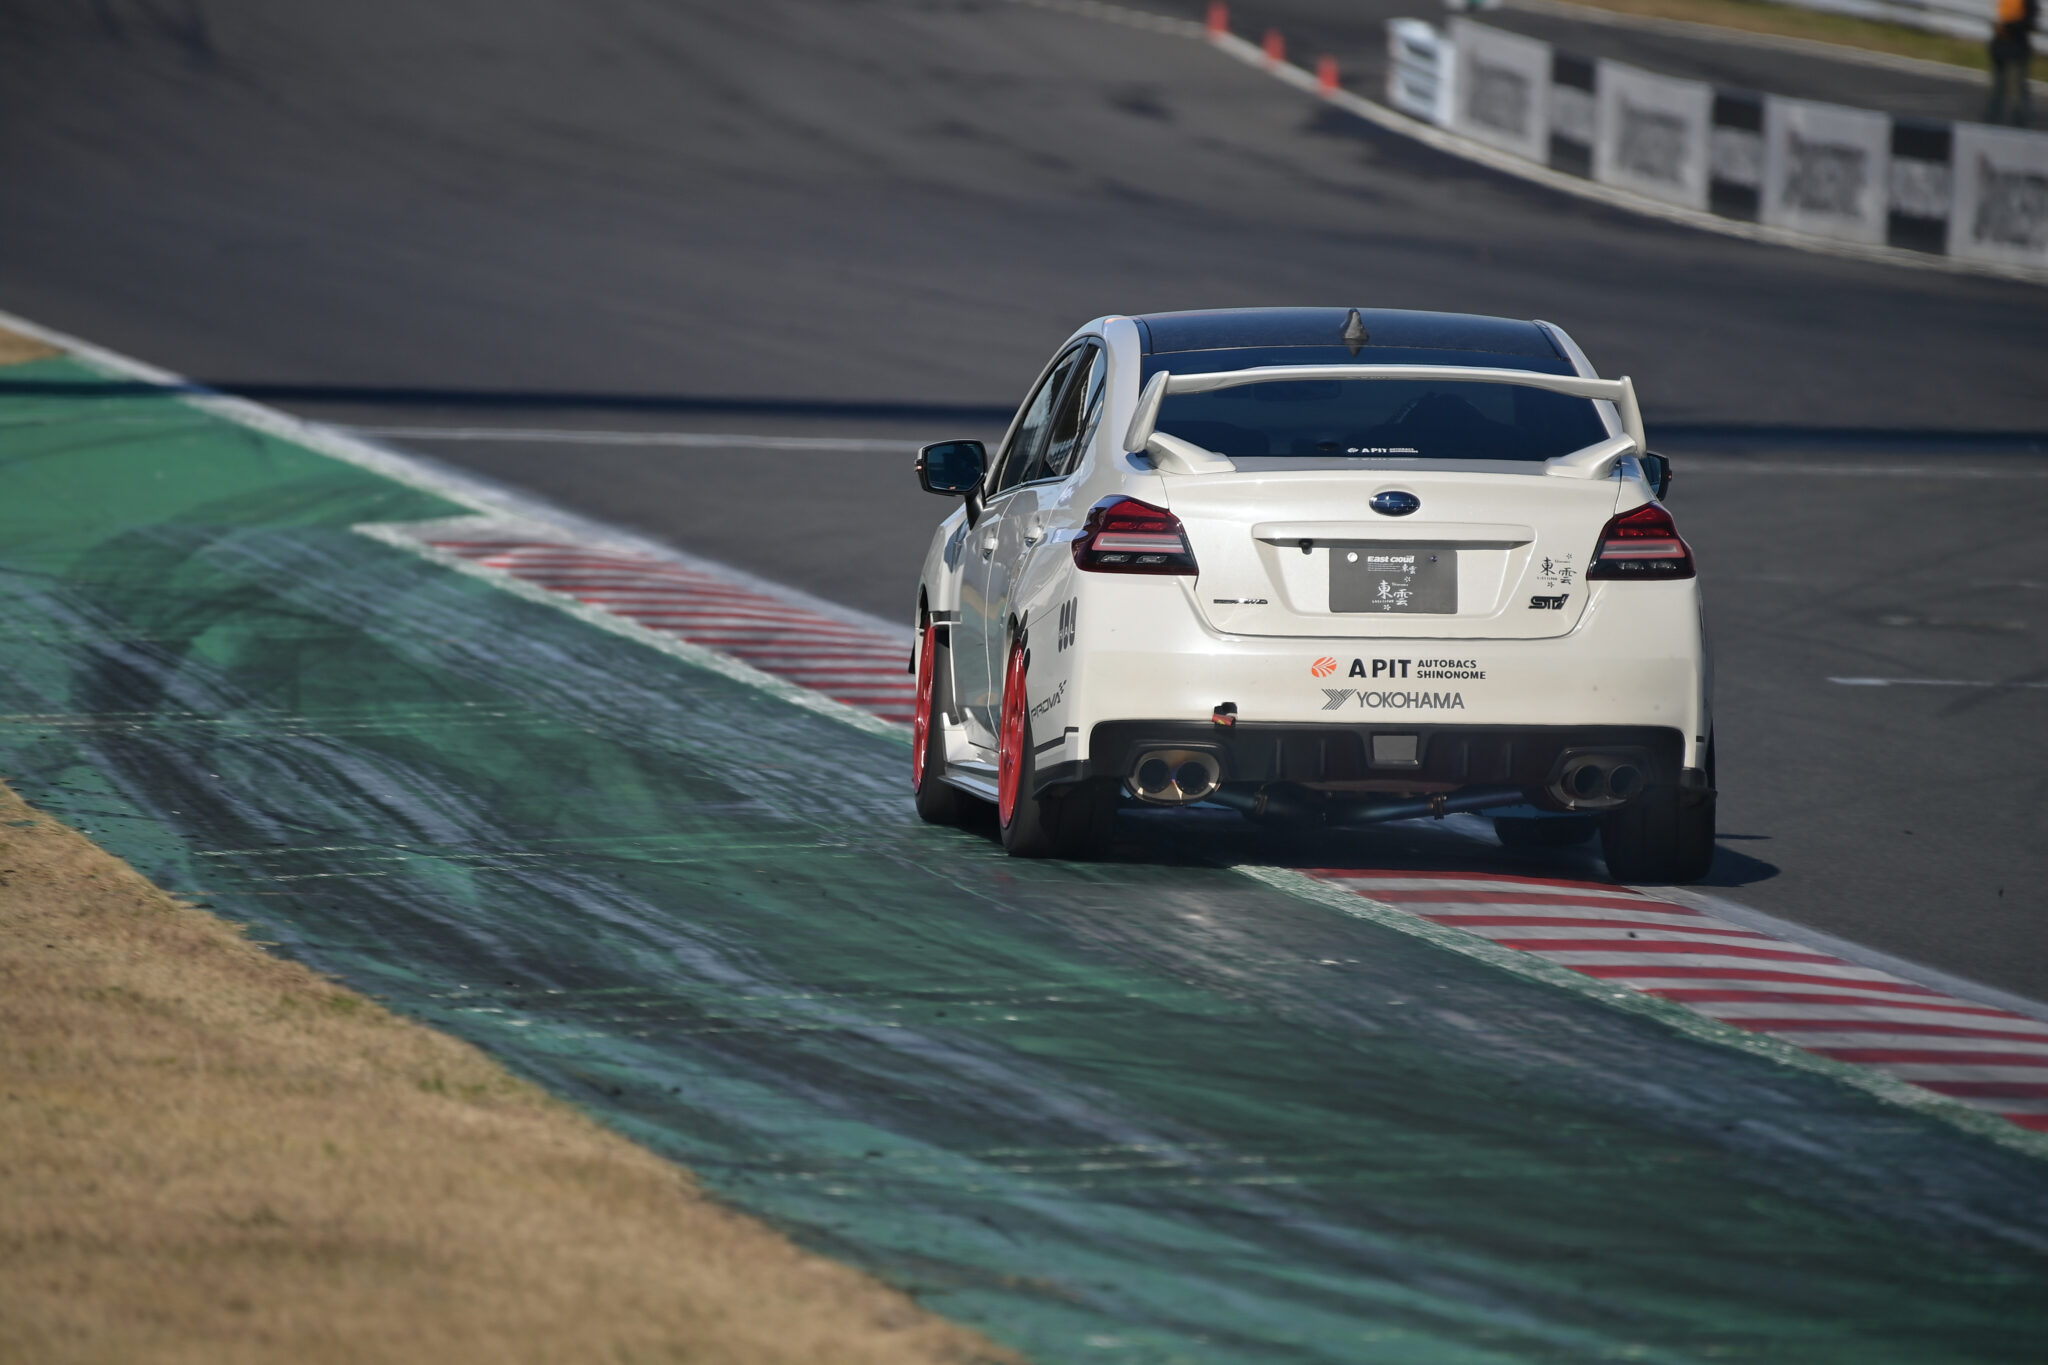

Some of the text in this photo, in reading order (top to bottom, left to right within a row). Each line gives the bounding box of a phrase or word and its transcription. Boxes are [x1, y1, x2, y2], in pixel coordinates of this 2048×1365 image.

[1541, 556, 1577, 585] 東雲
[1376, 579, 1414, 606] 東雲
[1417, 659, 1477, 669] AUTOBACS
[1416, 670, 1486, 680] SHINONOME
[1356, 691, 1465, 709] YOKOHAMA
